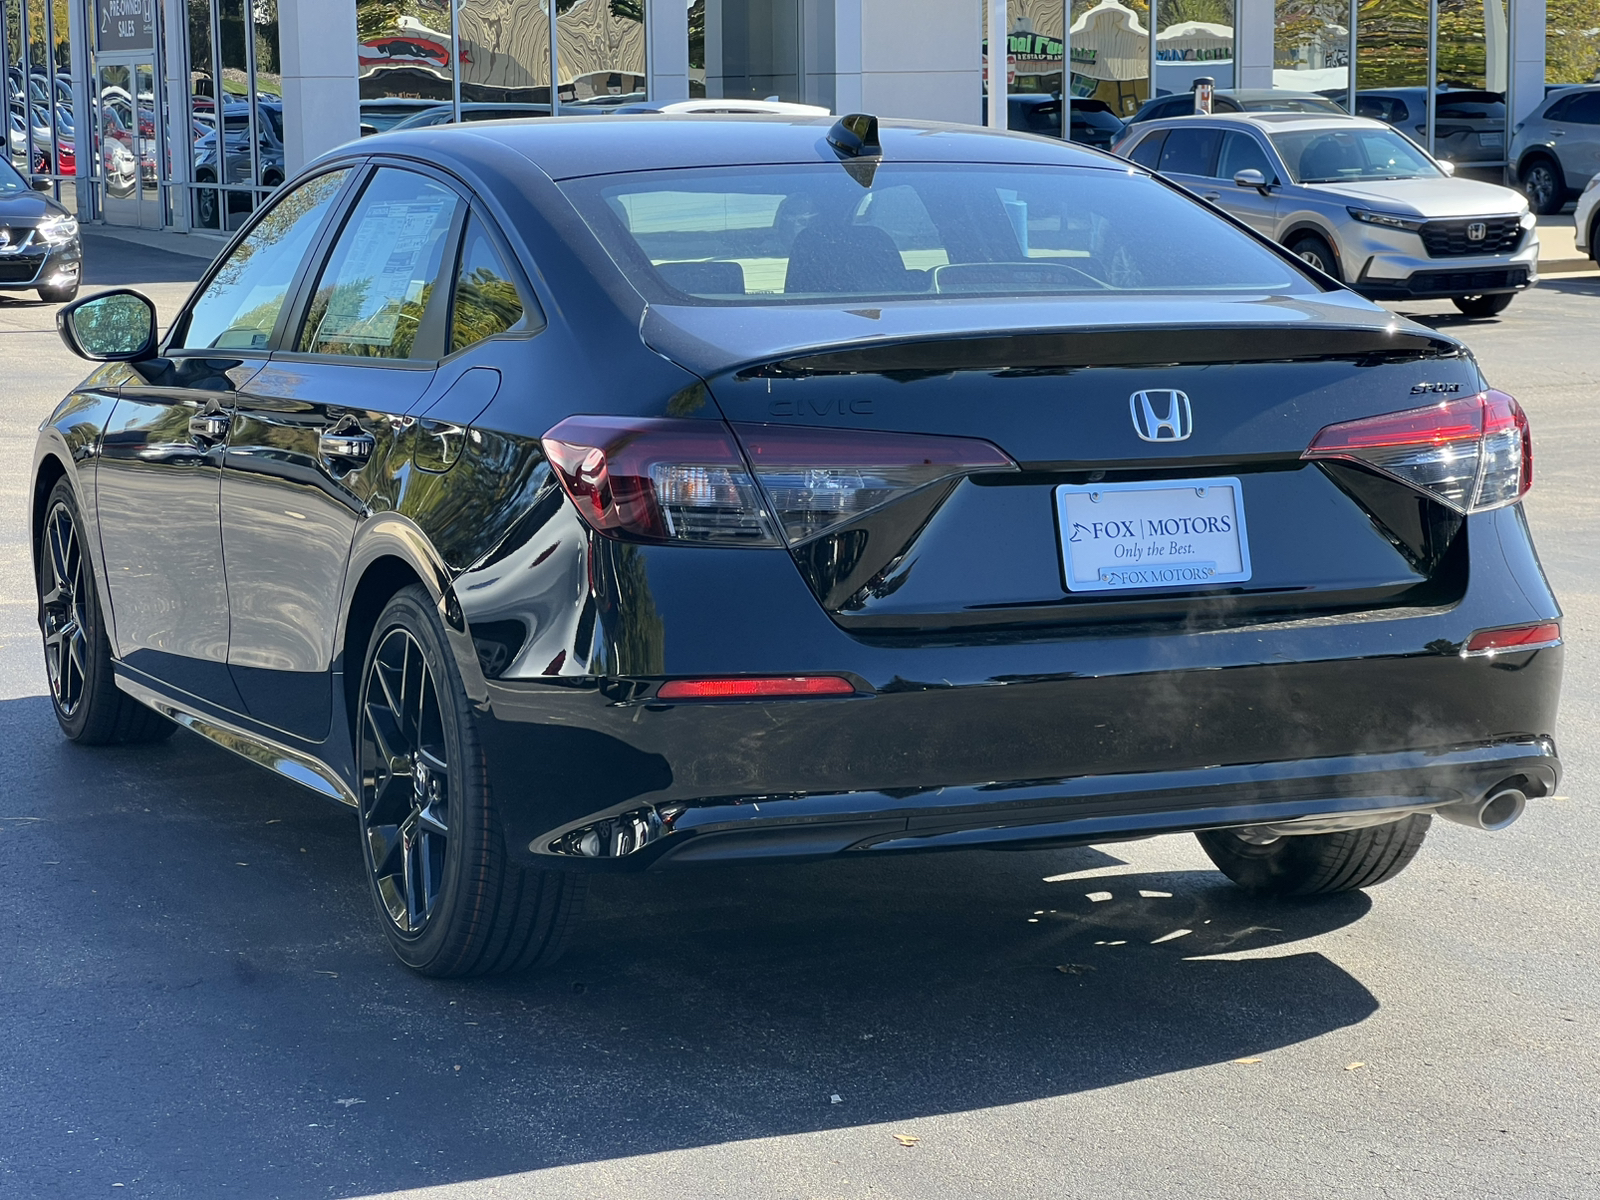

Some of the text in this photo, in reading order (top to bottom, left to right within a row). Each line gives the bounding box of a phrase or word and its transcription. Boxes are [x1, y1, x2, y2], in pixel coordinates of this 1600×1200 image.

[118, 20, 135, 37] SALES
[768, 399, 875, 416] CIVIC
[1091, 515, 1231, 540] FOX MOTORS
[1114, 541, 1195, 562] Only the Best.
[1121, 567, 1209, 585] FOX MOTORS
